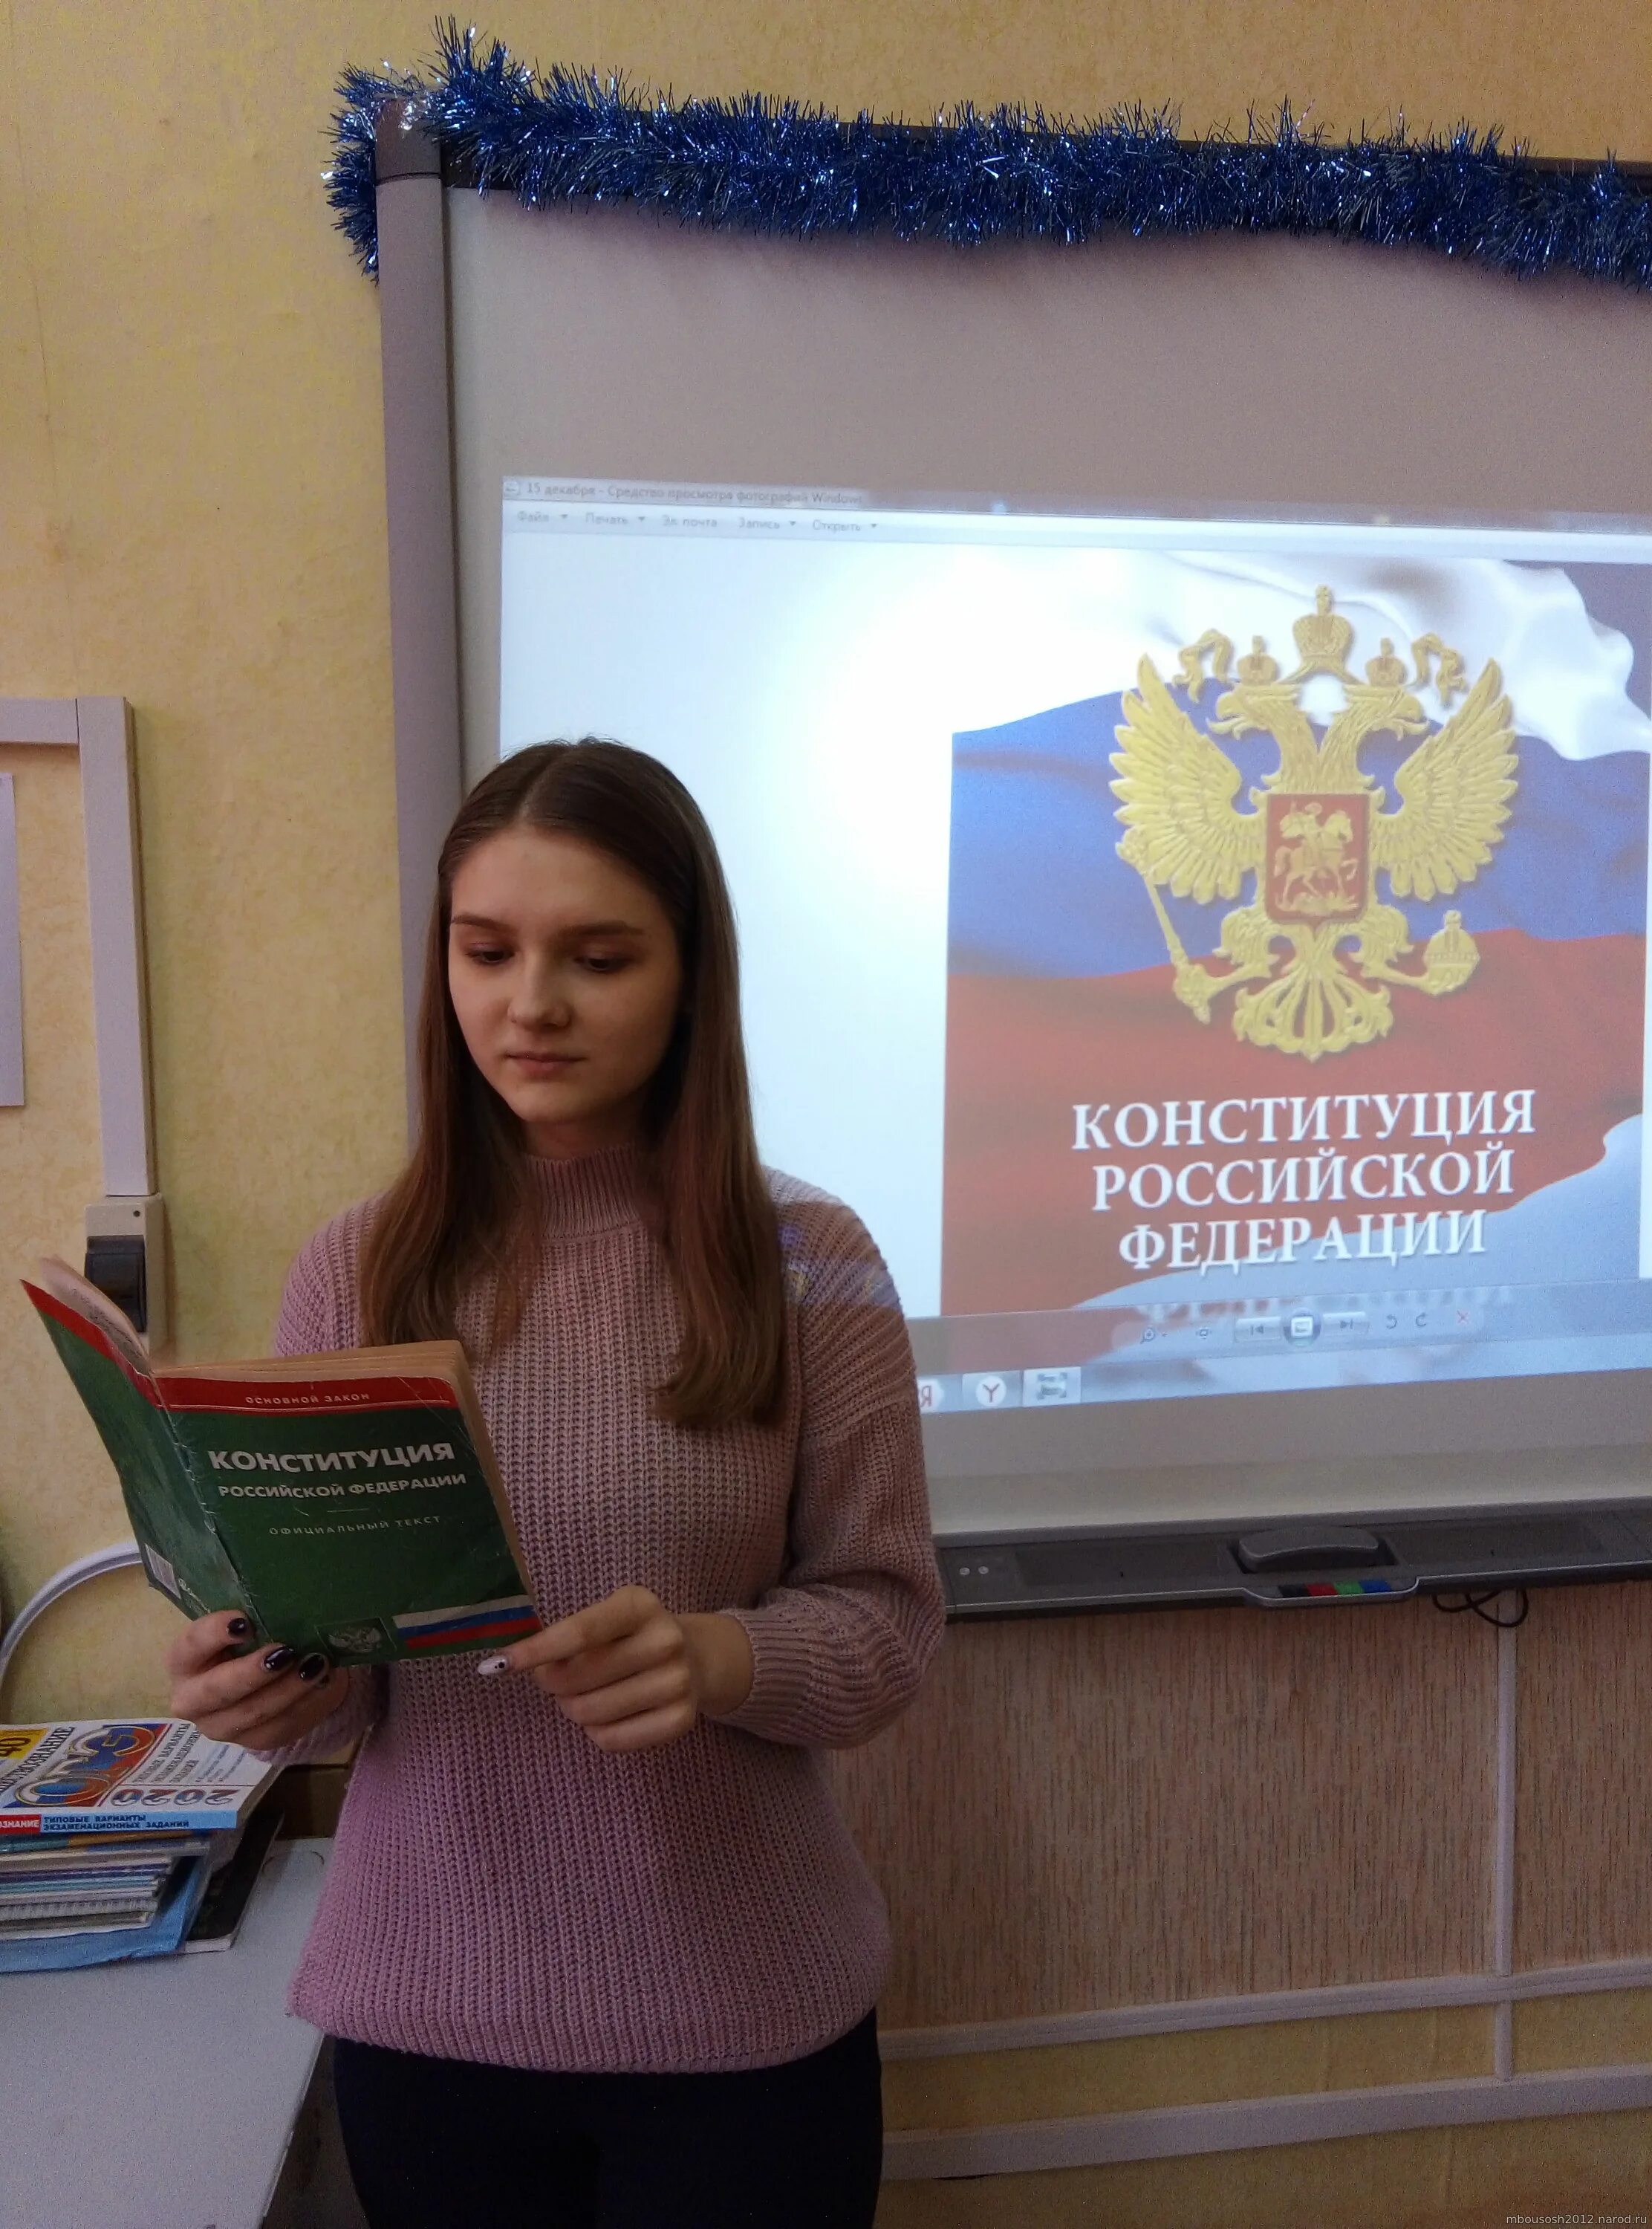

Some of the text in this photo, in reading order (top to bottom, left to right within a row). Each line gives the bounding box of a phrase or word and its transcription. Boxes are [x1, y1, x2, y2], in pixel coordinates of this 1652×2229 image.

[527, 483, 541, 494] 15
[544, 484, 595, 499] декабря
[607, 485, 665, 499] Средство
[585, 512, 628, 525] Печать
[683, 518, 718, 528] почта
[738, 518, 780, 530] Запись
[813, 519, 861, 533] Открыть
[1071, 1088, 1536, 1151] КОНСТИТУЦИЯ
[1091, 1141, 1515, 1212] РОССИЙСКОЙ
[1118, 1209, 1487, 1277] ФЕДЕРАЦИИ
[245, 1393, 370, 1405] ОСНОВНОЙ ЗАКОН
[208, 1442, 456, 1473] КОНСТИТУЦИЯ
[218, 1473, 467, 1499] РОССИЙСКОЙ ФЕДЕРАЦИИ
[269, 1515, 440, 1535] ОФИЦИАЛЬНЫЙ ТЕКСТ
[111, 1788, 240, 1806] 2020
